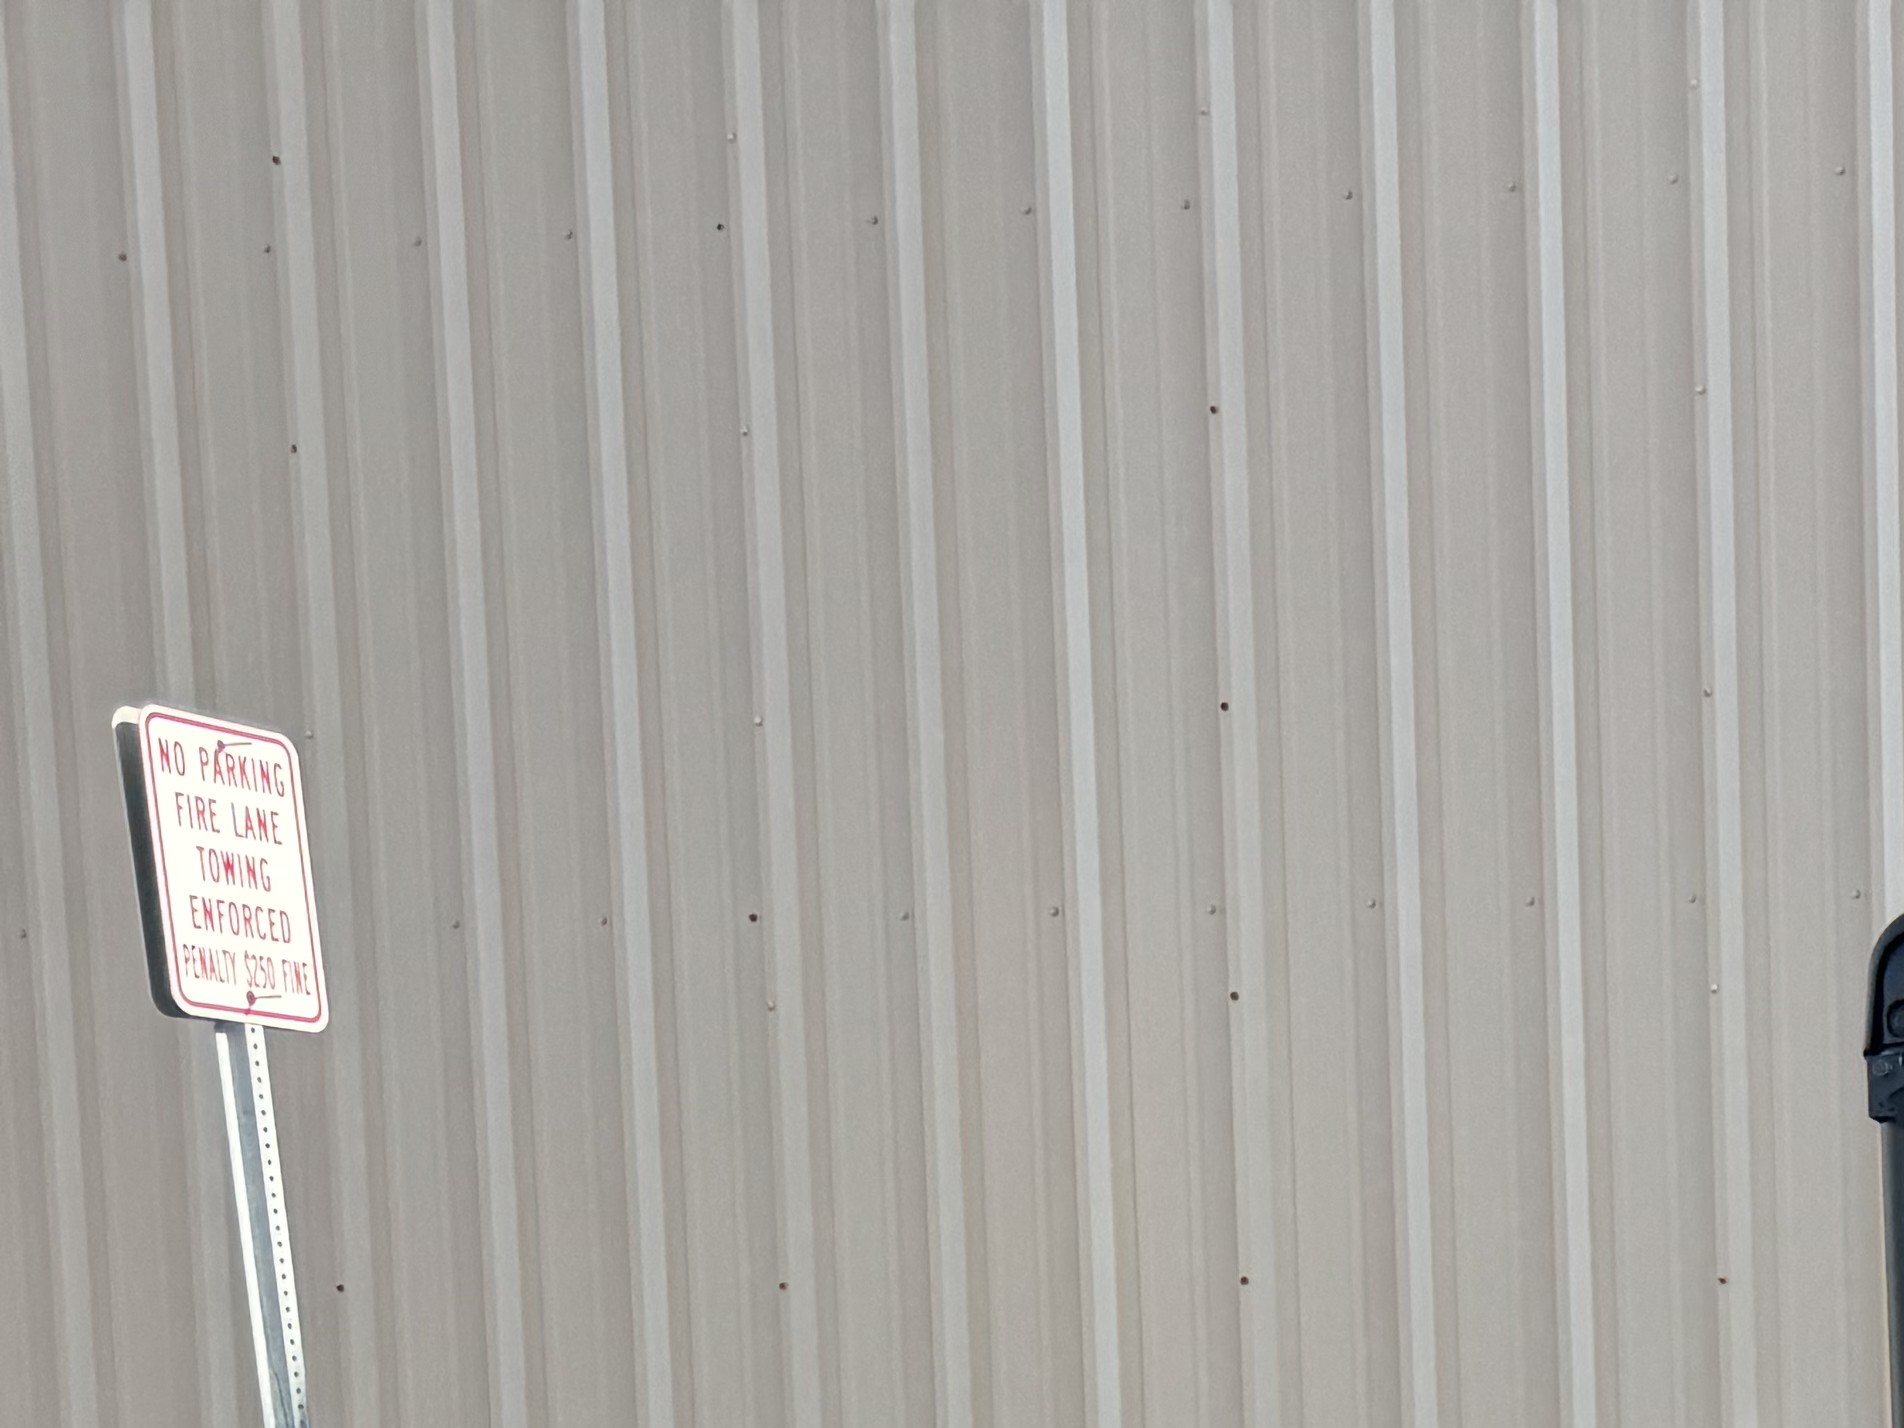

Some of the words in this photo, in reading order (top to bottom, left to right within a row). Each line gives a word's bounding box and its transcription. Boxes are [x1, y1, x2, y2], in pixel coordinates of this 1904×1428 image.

[157, 737, 187, 777] NO
[199, 746, 286, 798] PARKING
[174, 791, 221, 835] FIRE
[230, 802, 283, 846] LANE
[195, 846, 272, 893] TOWING
[189, 894, 292, 944] ENFORCED
[182, 943, 237, 986] PENALTY
[244, 950, 276, 991] $250
[282, 960, 312, 996] FINE
